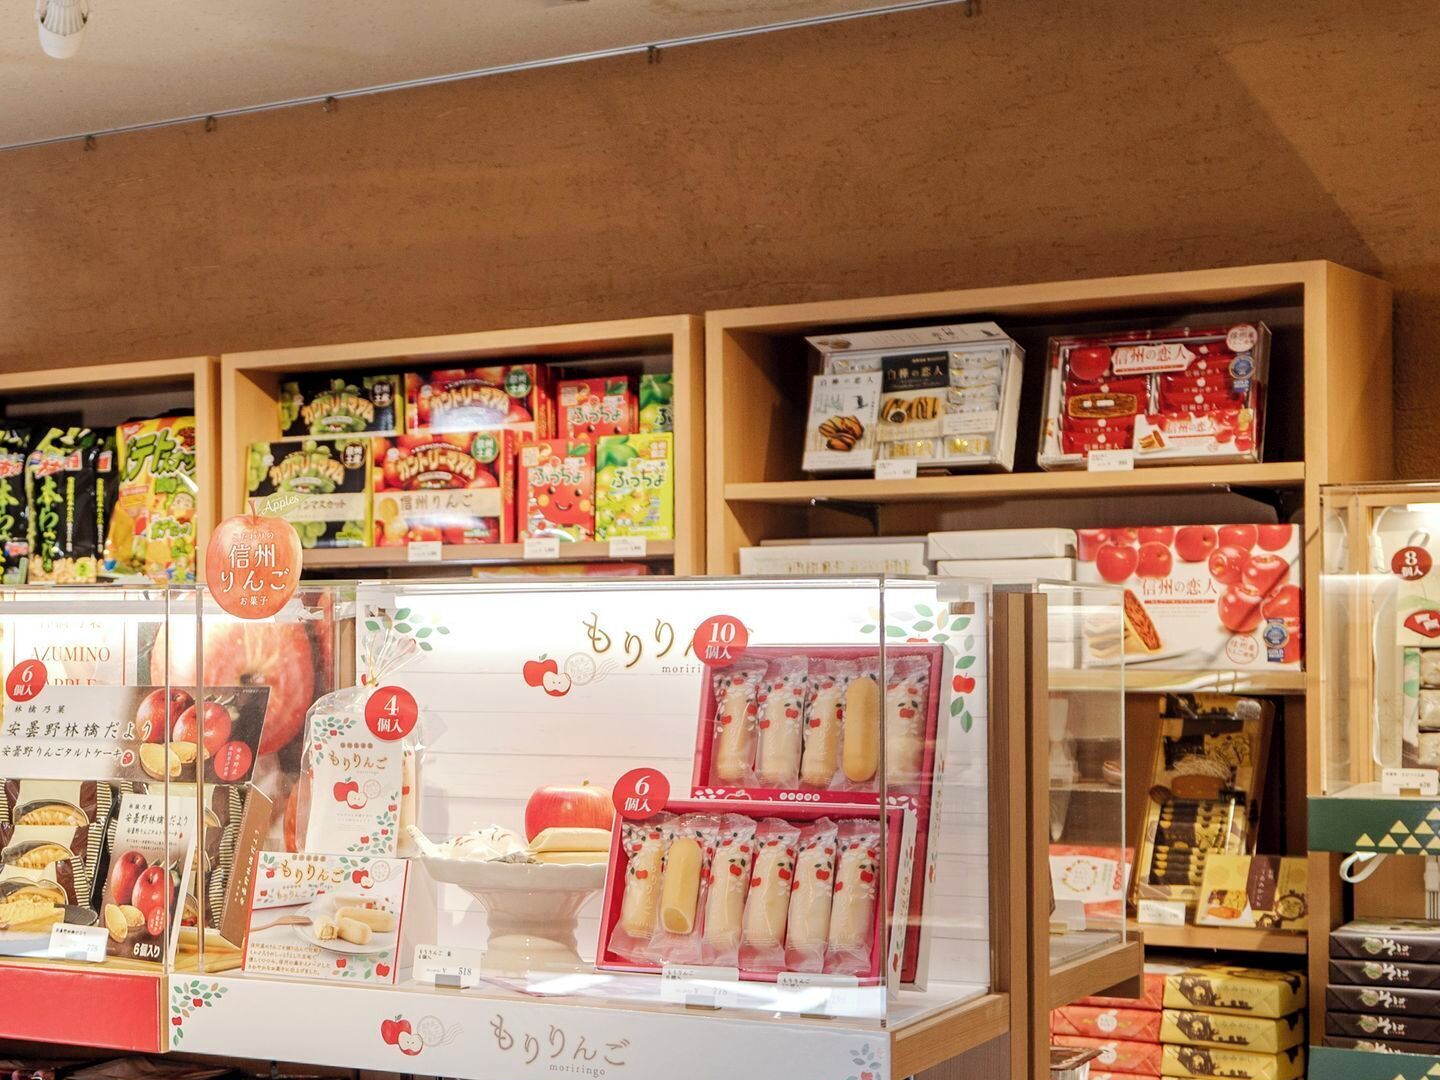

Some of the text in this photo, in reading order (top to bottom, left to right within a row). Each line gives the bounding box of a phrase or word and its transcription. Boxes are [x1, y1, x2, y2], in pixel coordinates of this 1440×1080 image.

[1114, 345, 1187, 366] 信州の恋人
[269, 456, 346, 487] カントリーマアム
[396, 449, 477, 482] カントリーマアム
[261, 495, 300, 516] Apples
[400, 493, 473, 511] 信州りんご
[229, 543, 275, 569] 信州
[1405, 550, 1418, 566] 8
[221, 568, 290, 593] りんご
[1142, 578, 1218, 596] 信州の恋人
[240, 595, 268, 606] お菓子
[708, 622, 736, 644] 10
[705, 644, 733, 660] 個入
[21, 665, 34, 683] 6
[662, 664, 701, 674] moriri
[13, 683, 33, 697] 個入
[383, 694, 400, 717] 4
[6, 720, 153, 741] 安曇野林檎だより
[376, 717, 403, 733] 個入
[1, 745, 123, 759] 安曇野りんごタルトケーキ
[329, 750, 388, 772] もりりんご
[634, 775, 650, 796] 6
[624, 796, 652, 813] 個入
[281, 859, 345, 885] もりりんご
[132, 942, 162, 959] 6個入り
[490, 1013, 631, 1066] もりりんご
[549, 1062, 606, 1079] moriringo
